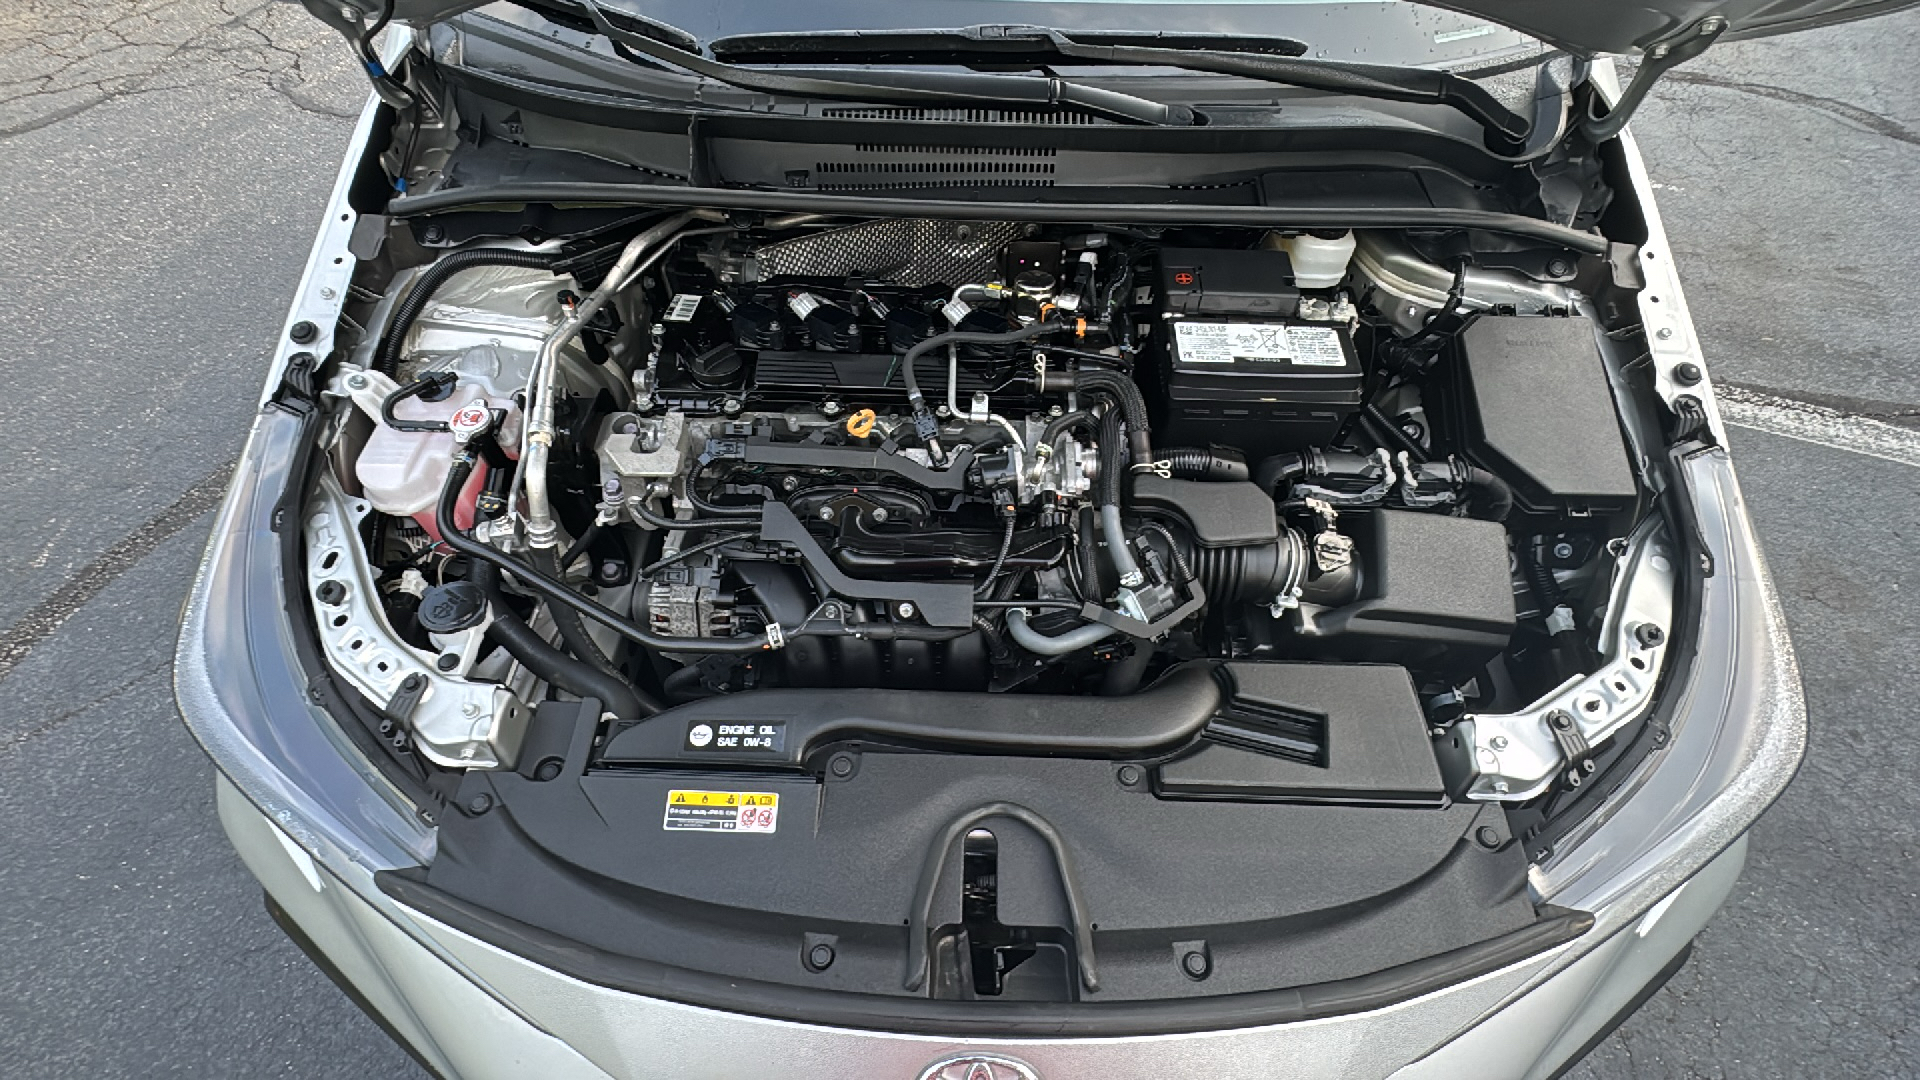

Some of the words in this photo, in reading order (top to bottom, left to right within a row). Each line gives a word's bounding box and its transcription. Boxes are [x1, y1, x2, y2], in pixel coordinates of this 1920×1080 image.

[718, 725, 754, 735] ENGINE
[759, 725, 776, 735] OIL
[717, 737, 738, 747] SAE
[743, 737, 772, 747] 0W-8
